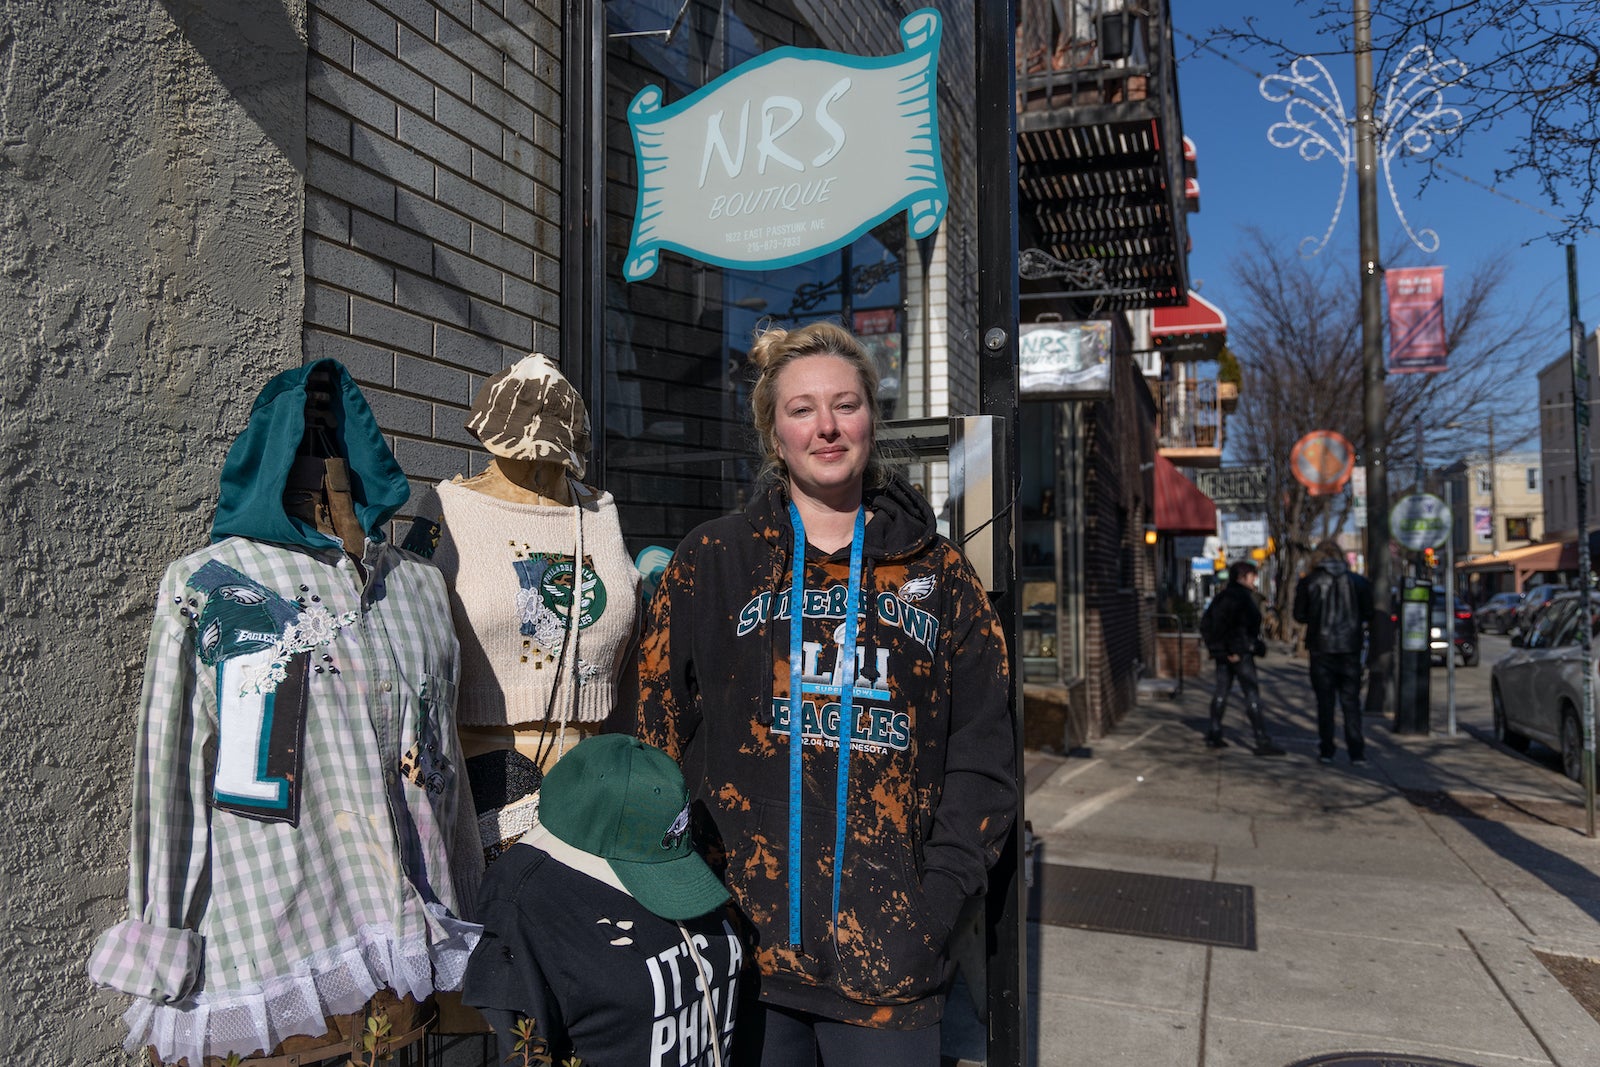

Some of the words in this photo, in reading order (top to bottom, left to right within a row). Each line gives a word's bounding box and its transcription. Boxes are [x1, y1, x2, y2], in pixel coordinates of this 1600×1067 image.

[698, 77, 852, 189] NRS
[708, 176, 838, 220] BOUTIQUE
[744, 227, 763, 241] EAST
[766, 221, 807, 237] PASSYUNK
[810, 218, 825, 232] AVE
[1021, 335, 1069, 354] NRS
[543, 563, 594, 584] PHILADELIA
[235, 629, 277, 645] EAGLES
[815, 685, 842, 696] SUPE
[770, 696, 911, 751] EAGLES
[801, 738, 834, 749] 2.04.18
[835, 742, 888, 755] NESOTA
[645, 933, 714, 1018] IT'S
